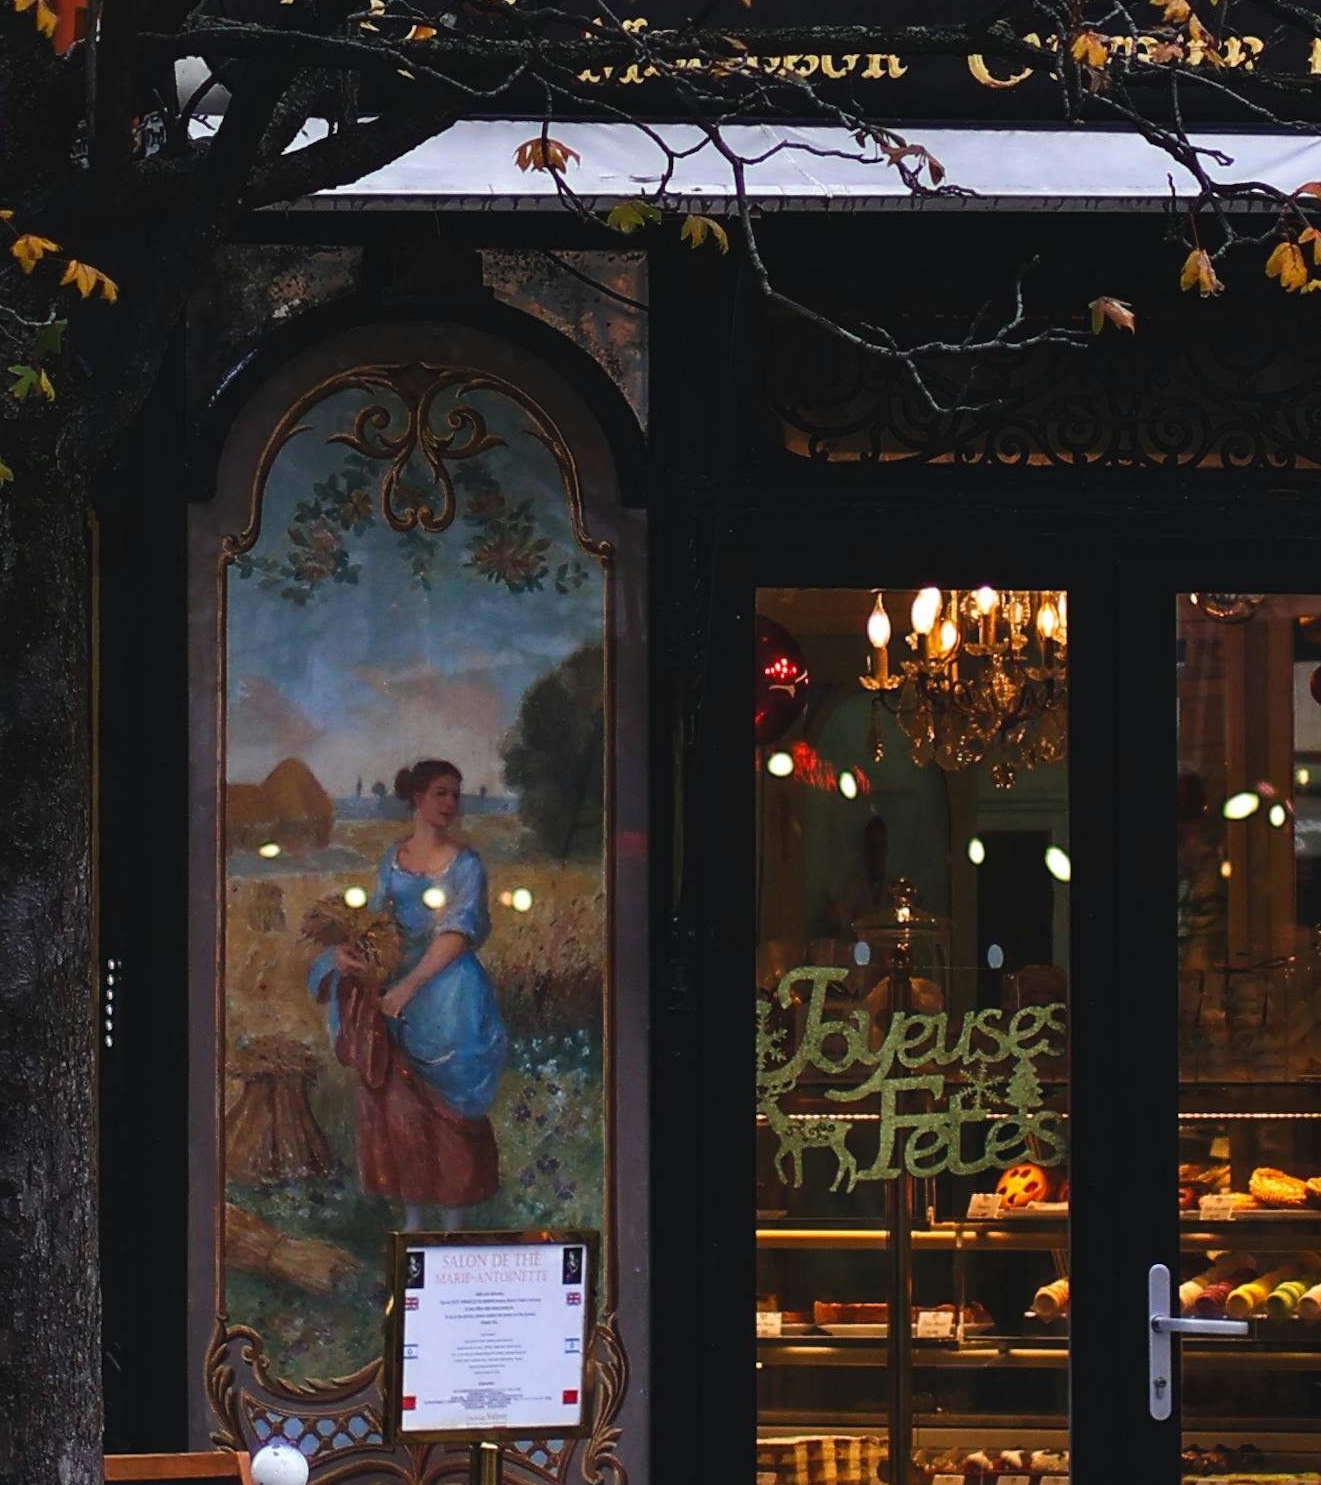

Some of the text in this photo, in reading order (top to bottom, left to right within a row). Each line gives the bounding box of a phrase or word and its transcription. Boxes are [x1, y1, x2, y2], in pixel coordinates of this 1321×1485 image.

[756, 965, 1067, 1103] Joyeuses
[443, 1253, 487, 1268] SALON
[492, 1252, 510, 1268] DE
